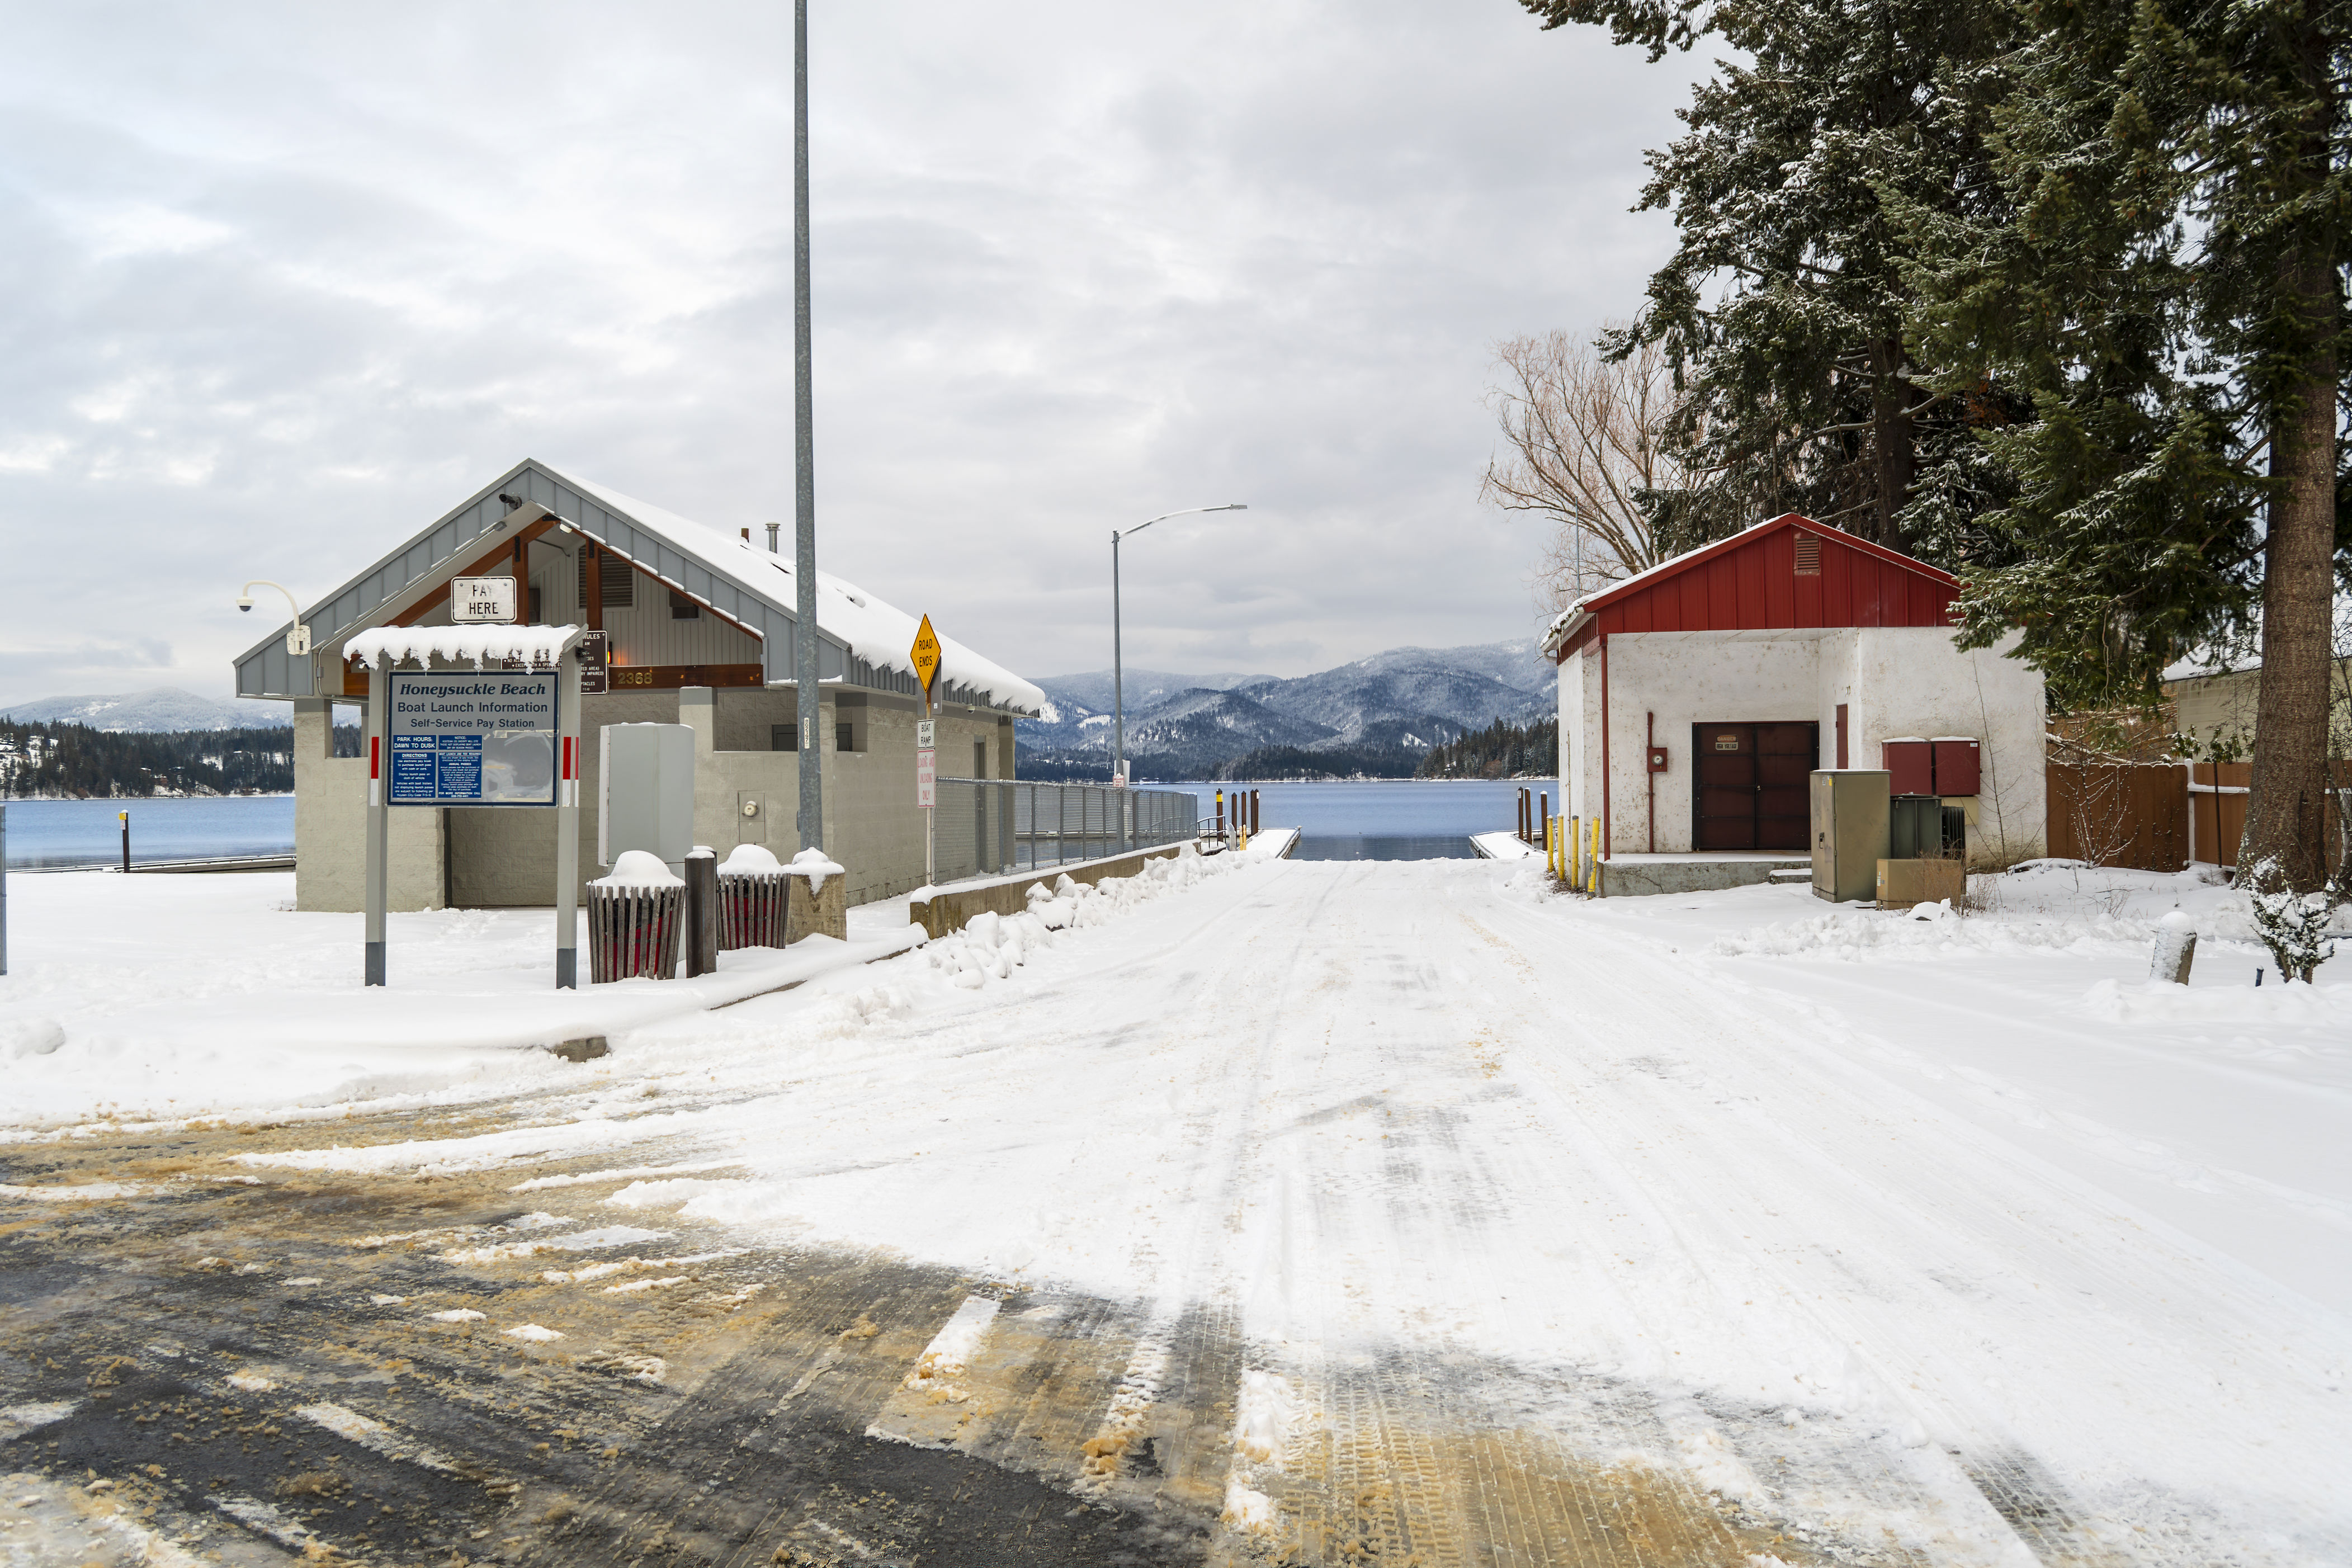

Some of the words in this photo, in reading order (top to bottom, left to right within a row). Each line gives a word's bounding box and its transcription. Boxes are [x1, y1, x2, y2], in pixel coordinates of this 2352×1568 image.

[470, 602, 498, 614] HERE
[919, 639, 932, 650] ROAD
[919, 655, 932, 667] ENDS
[617, 672, 653, 684] 2368
[400, 683, 495, 698] Honeysuckle
[500, 683, 546, 695] Beach
[398, 702, 426, 712] Boat
[431, 702, 474, 712] Launch
[479, 702, 547, 712] Information
[410, 719, 473, 727] Self-Service
[477, 719, 494, 729] Pay
[499, 719, 534, 727] Station
[922, 724, 931, 732] BOAT
[918, 757, 927, 768] LOADING
[920, 773, 932, 783] UNLOADING
